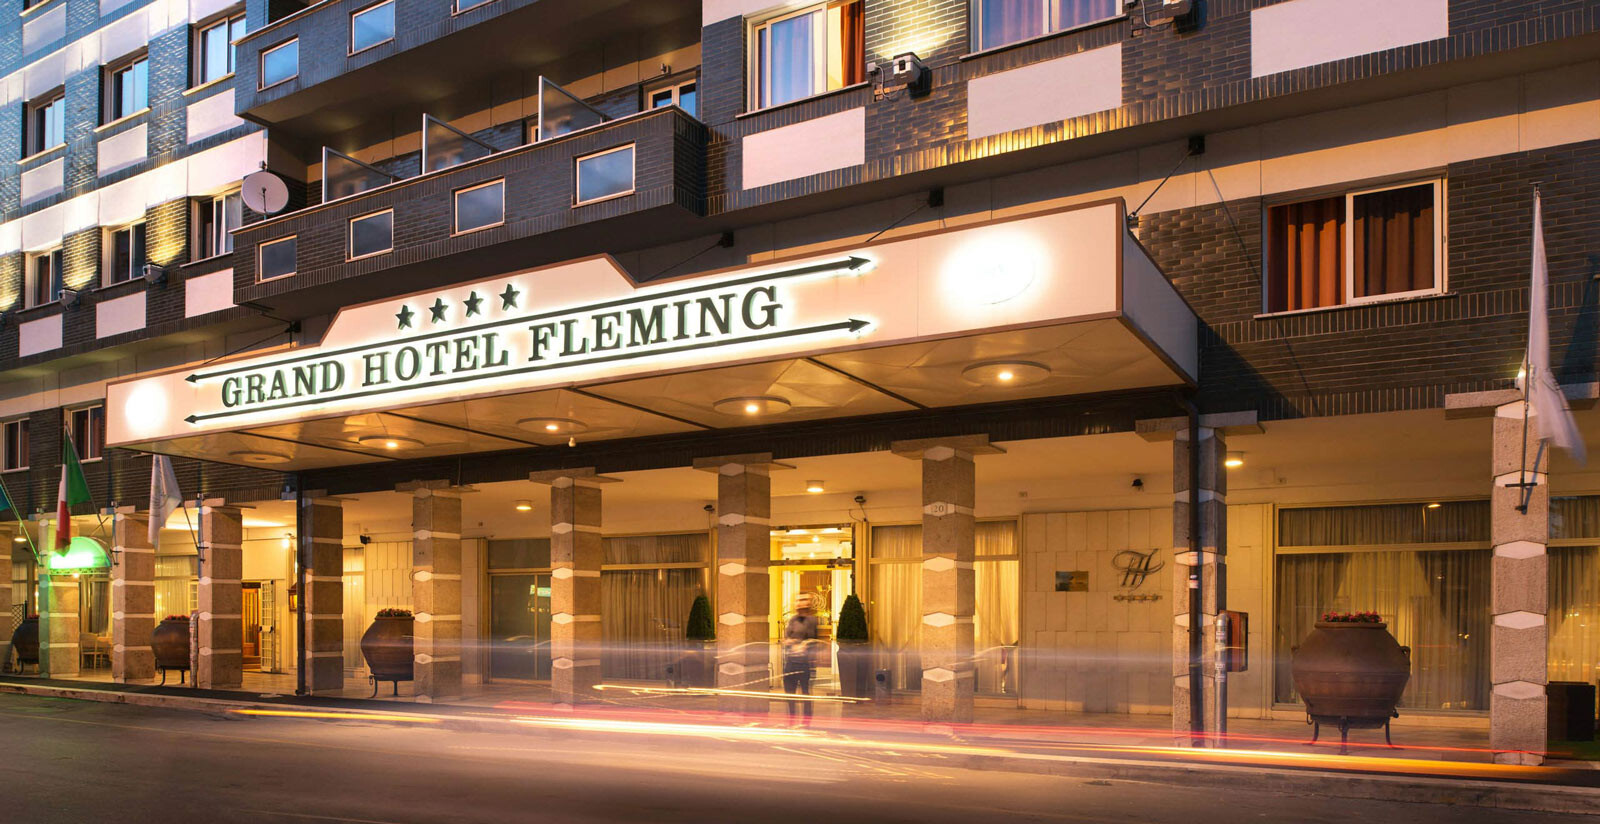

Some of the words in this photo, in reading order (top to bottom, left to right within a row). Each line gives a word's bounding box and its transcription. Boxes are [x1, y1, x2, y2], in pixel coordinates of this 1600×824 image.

[221, 359, 345, 408] GRAND
[361, 332, 509, 387] HOTEL
[528, 285, 783, 362] FLEMING
[933, 504, 944, 513] 20
